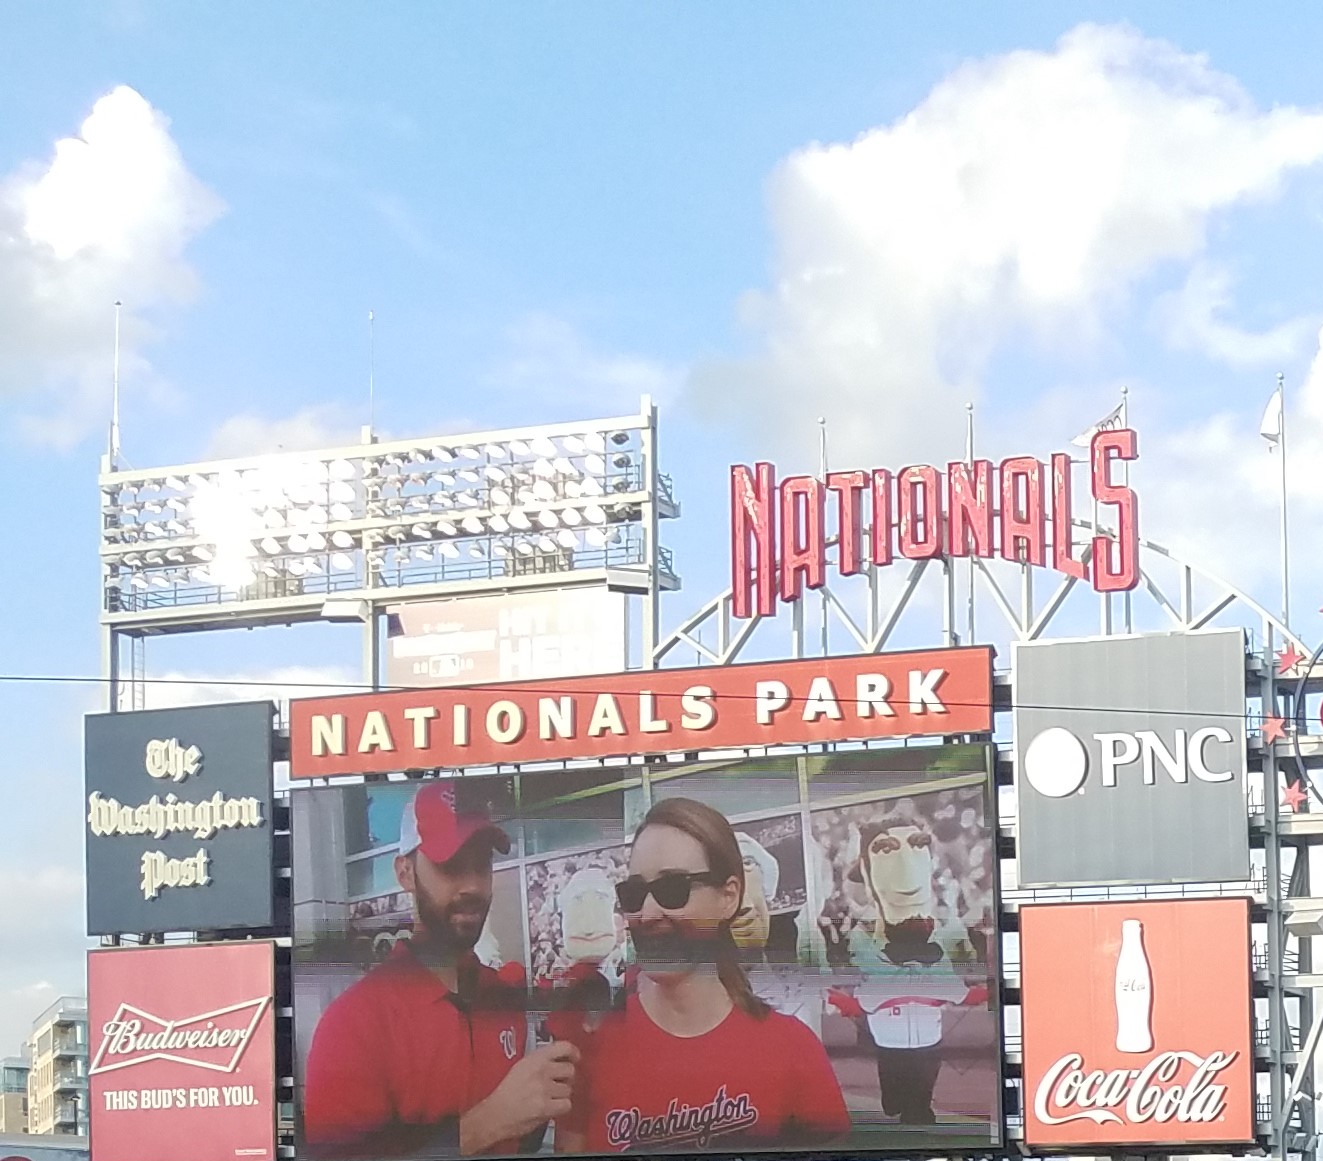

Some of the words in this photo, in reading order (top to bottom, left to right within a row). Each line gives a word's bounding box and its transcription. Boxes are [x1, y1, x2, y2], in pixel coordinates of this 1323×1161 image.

[729, 428, 1139, 618] NATIONALS
[310, 684, 717, 758] NATIONALS
[755, 666, 951, 725] PARK
[145, 738, 204, 781] The
[1094, 724, 1237, 788] PNC
[89, 788, 267, 843] Washington
[140, 847, 212, 900] Post
[102, 1016, 249, 1057] Budweiser
[103, 1090, 138, 1111] THIS
[140, 1088, 187, 1110] BUD'S
[189, 1086, 220, 1108] FOR
[222, 1084, 258, 1107] YOU.
[606, 1084, 758, 1148] Washington
[1034, 1049, 1239, 1126] Coca-Cola
